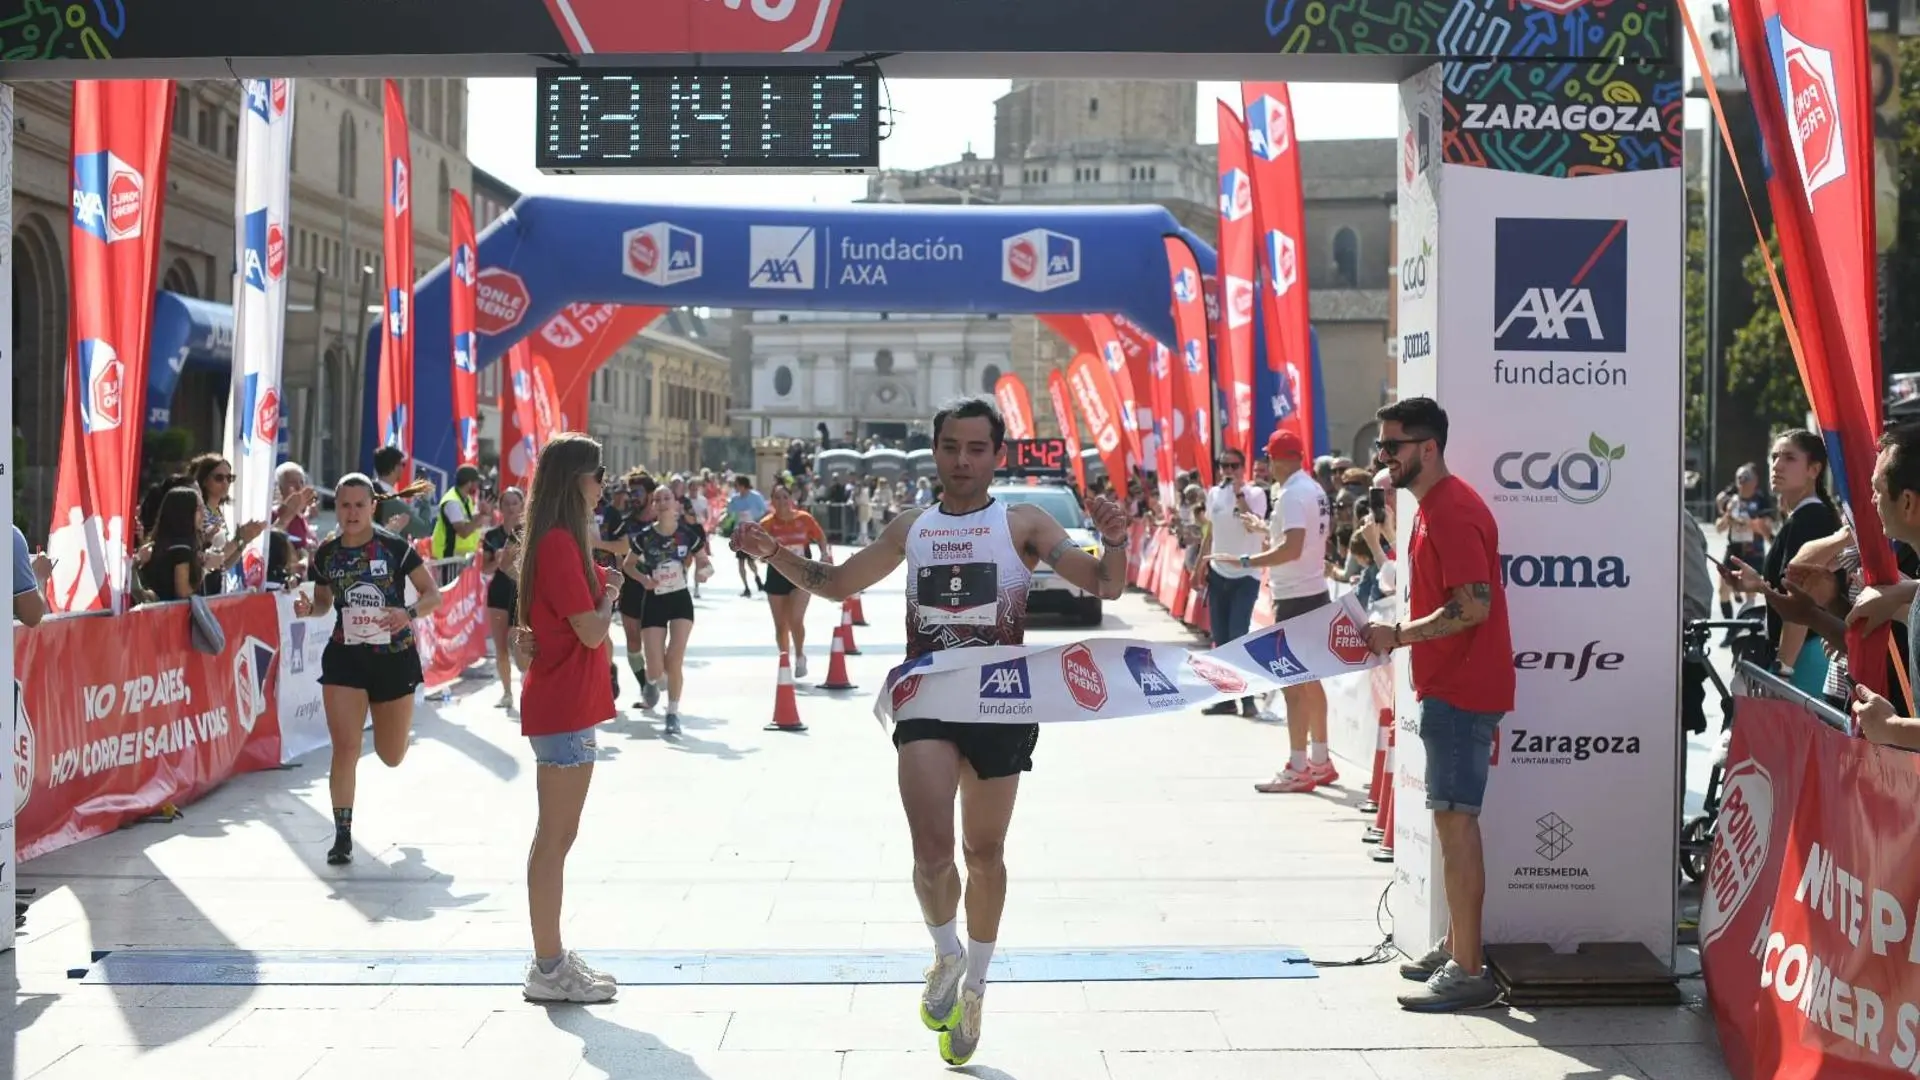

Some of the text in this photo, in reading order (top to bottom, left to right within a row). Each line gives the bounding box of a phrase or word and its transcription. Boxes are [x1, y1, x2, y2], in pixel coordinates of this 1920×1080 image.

[1462, 103, 1661, 132] ZARAGOZA
[841, 237, 963, 260] fundación
[751, 259, 802, 284] AXA
[840, 265, 888, 285] AXA
[477, 282, 522, 310] ONLE
[1495, 287, 1604, 340] AXA
[1494, 359, 1627, 385] fundación
[999, 440, 1064, 468] 1:42
[932, 541, 973, 552] belsue
[950, 577, 962, 592] 8
[1336, 625, 1361, 636] PON
[1067, 659, 1099, 683] PONLE
[1268, 656, 1299, 676] AXA
[1513, 640, 1625, 682] enfe
[980, 668, 1024, 694] AXA
[1068, 671, 1100, 695] FRENO
[83, 684, 117, 722] NO
[979, 701, 1033, 716] fundación
[1511, 730, 1640, 760] Zaragoza
[49, 748, 80, 789] HOY
[1511, 757, 1571, 765] AYUNTAMIENTO
[1721, 785, 1762, 881] PONLE
[1514, 867, 1590, 877] ATRESMEDIA
[1836, 867, 1863, 948] TE
[1760, 932, 1884, 1055] CORRER
